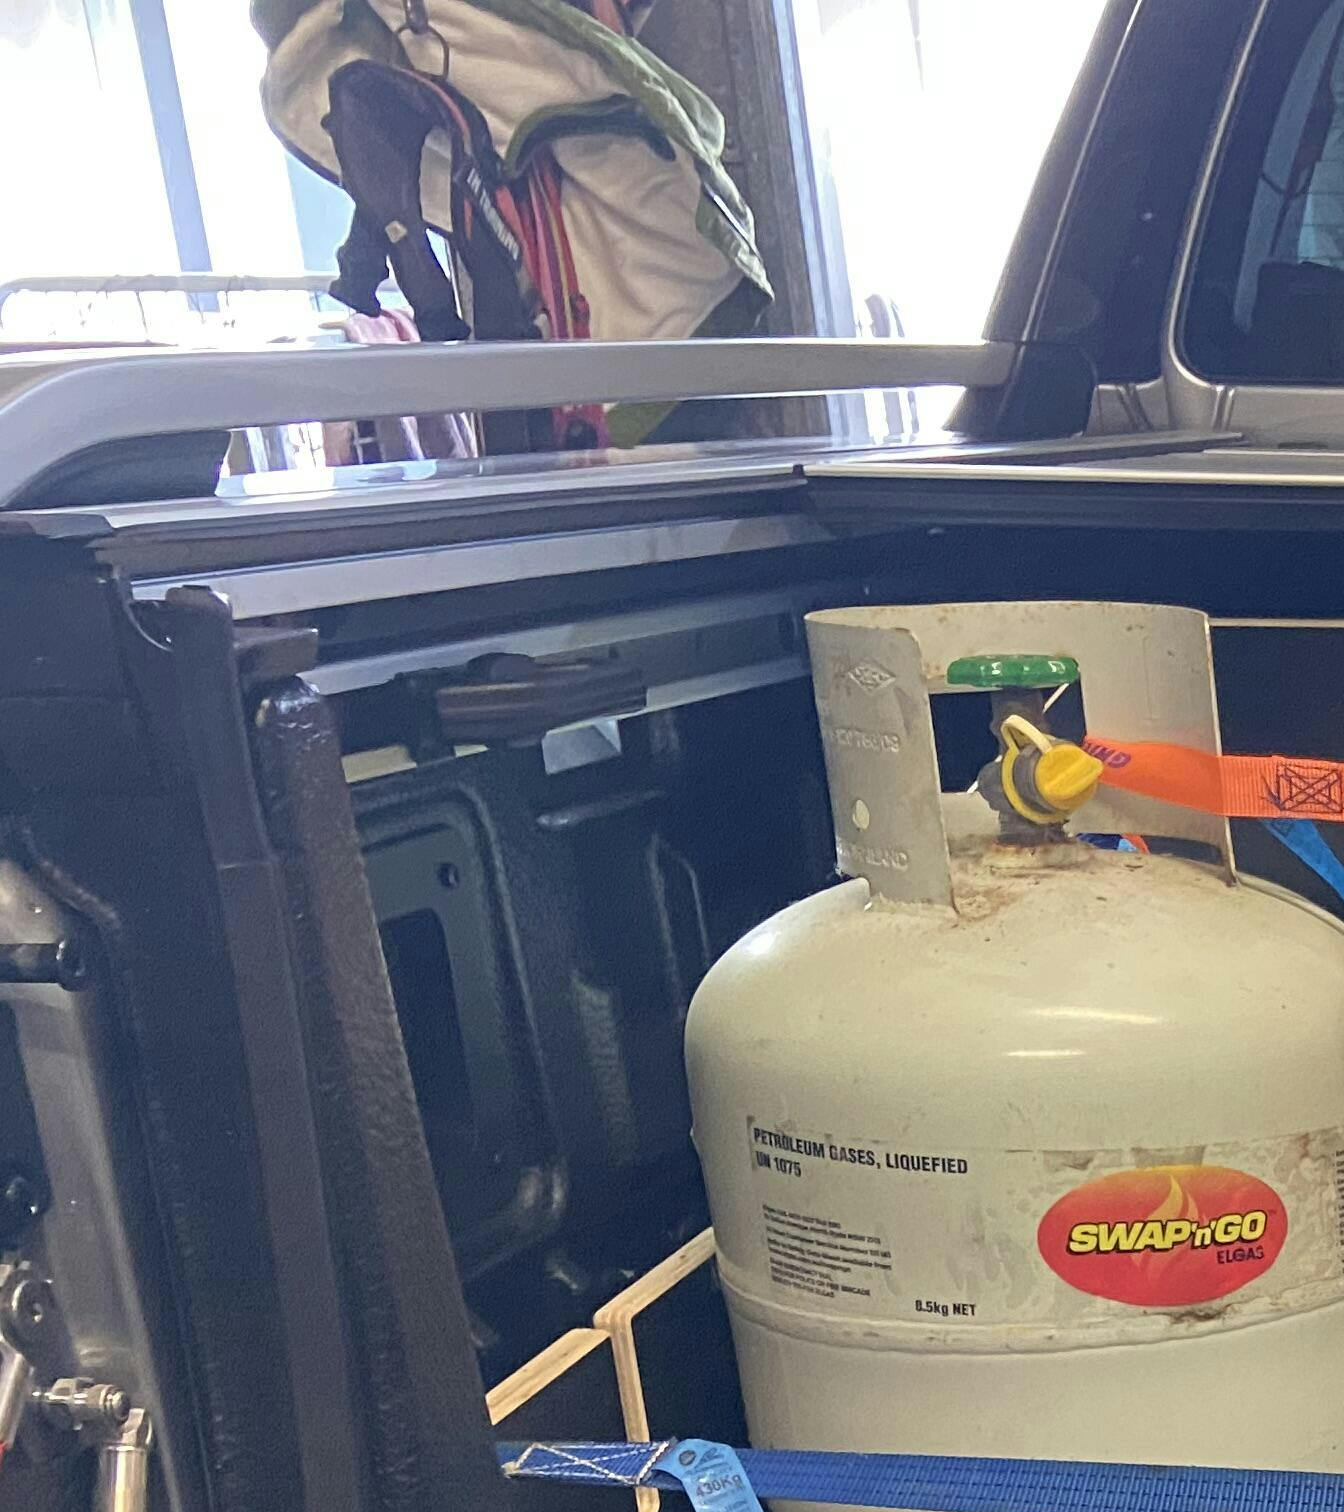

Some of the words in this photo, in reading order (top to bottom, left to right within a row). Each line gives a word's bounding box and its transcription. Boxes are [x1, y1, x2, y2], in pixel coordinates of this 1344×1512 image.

[753, 1127, 825, 1158] PETROLEUM
[829, 1145, 881, 1169] GASES,
[886, 1153, 968, 1174] LIQUEFIED
[756, 1151, 771, 1168] UN
[774, 1157, 802, 1177] 1075
[1216, 1245, 1265, 1264] ELGAS
[953, 1302, 976, 1316] NET
